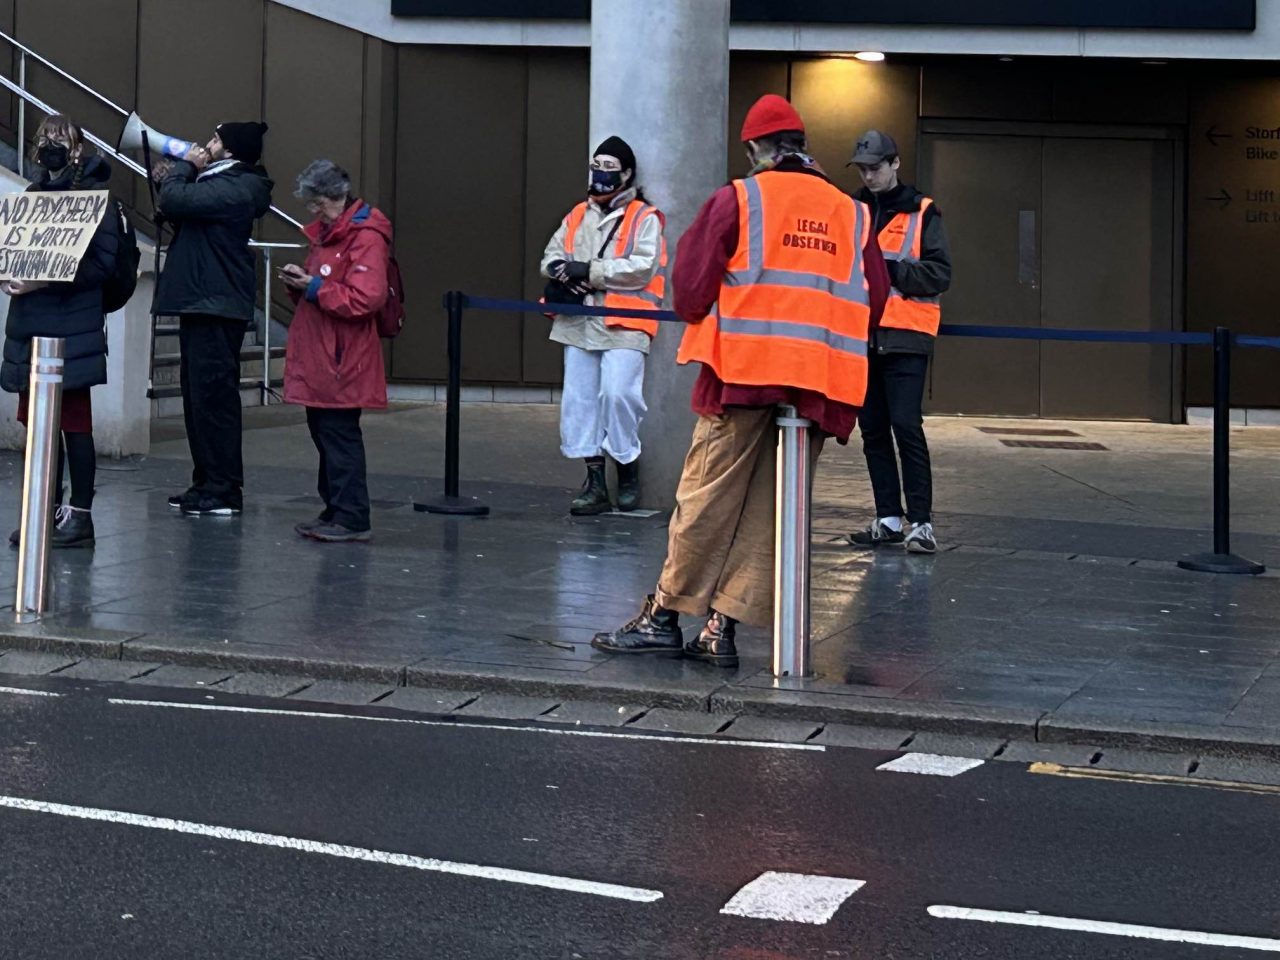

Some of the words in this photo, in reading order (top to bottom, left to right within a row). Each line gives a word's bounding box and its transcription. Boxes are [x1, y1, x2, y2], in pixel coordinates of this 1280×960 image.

[1246, 146, 1279, 160] Bike
[26, 195, 107, 224] PAYCHECK
[4, 226, 26, 246] IS
[28, 226, 84, 247] WORTH
[797, 218, 828, 235] LEGAL
[782, 233, 837, 255] OBSERVER
[48, 252, 81, 279] LIVES
